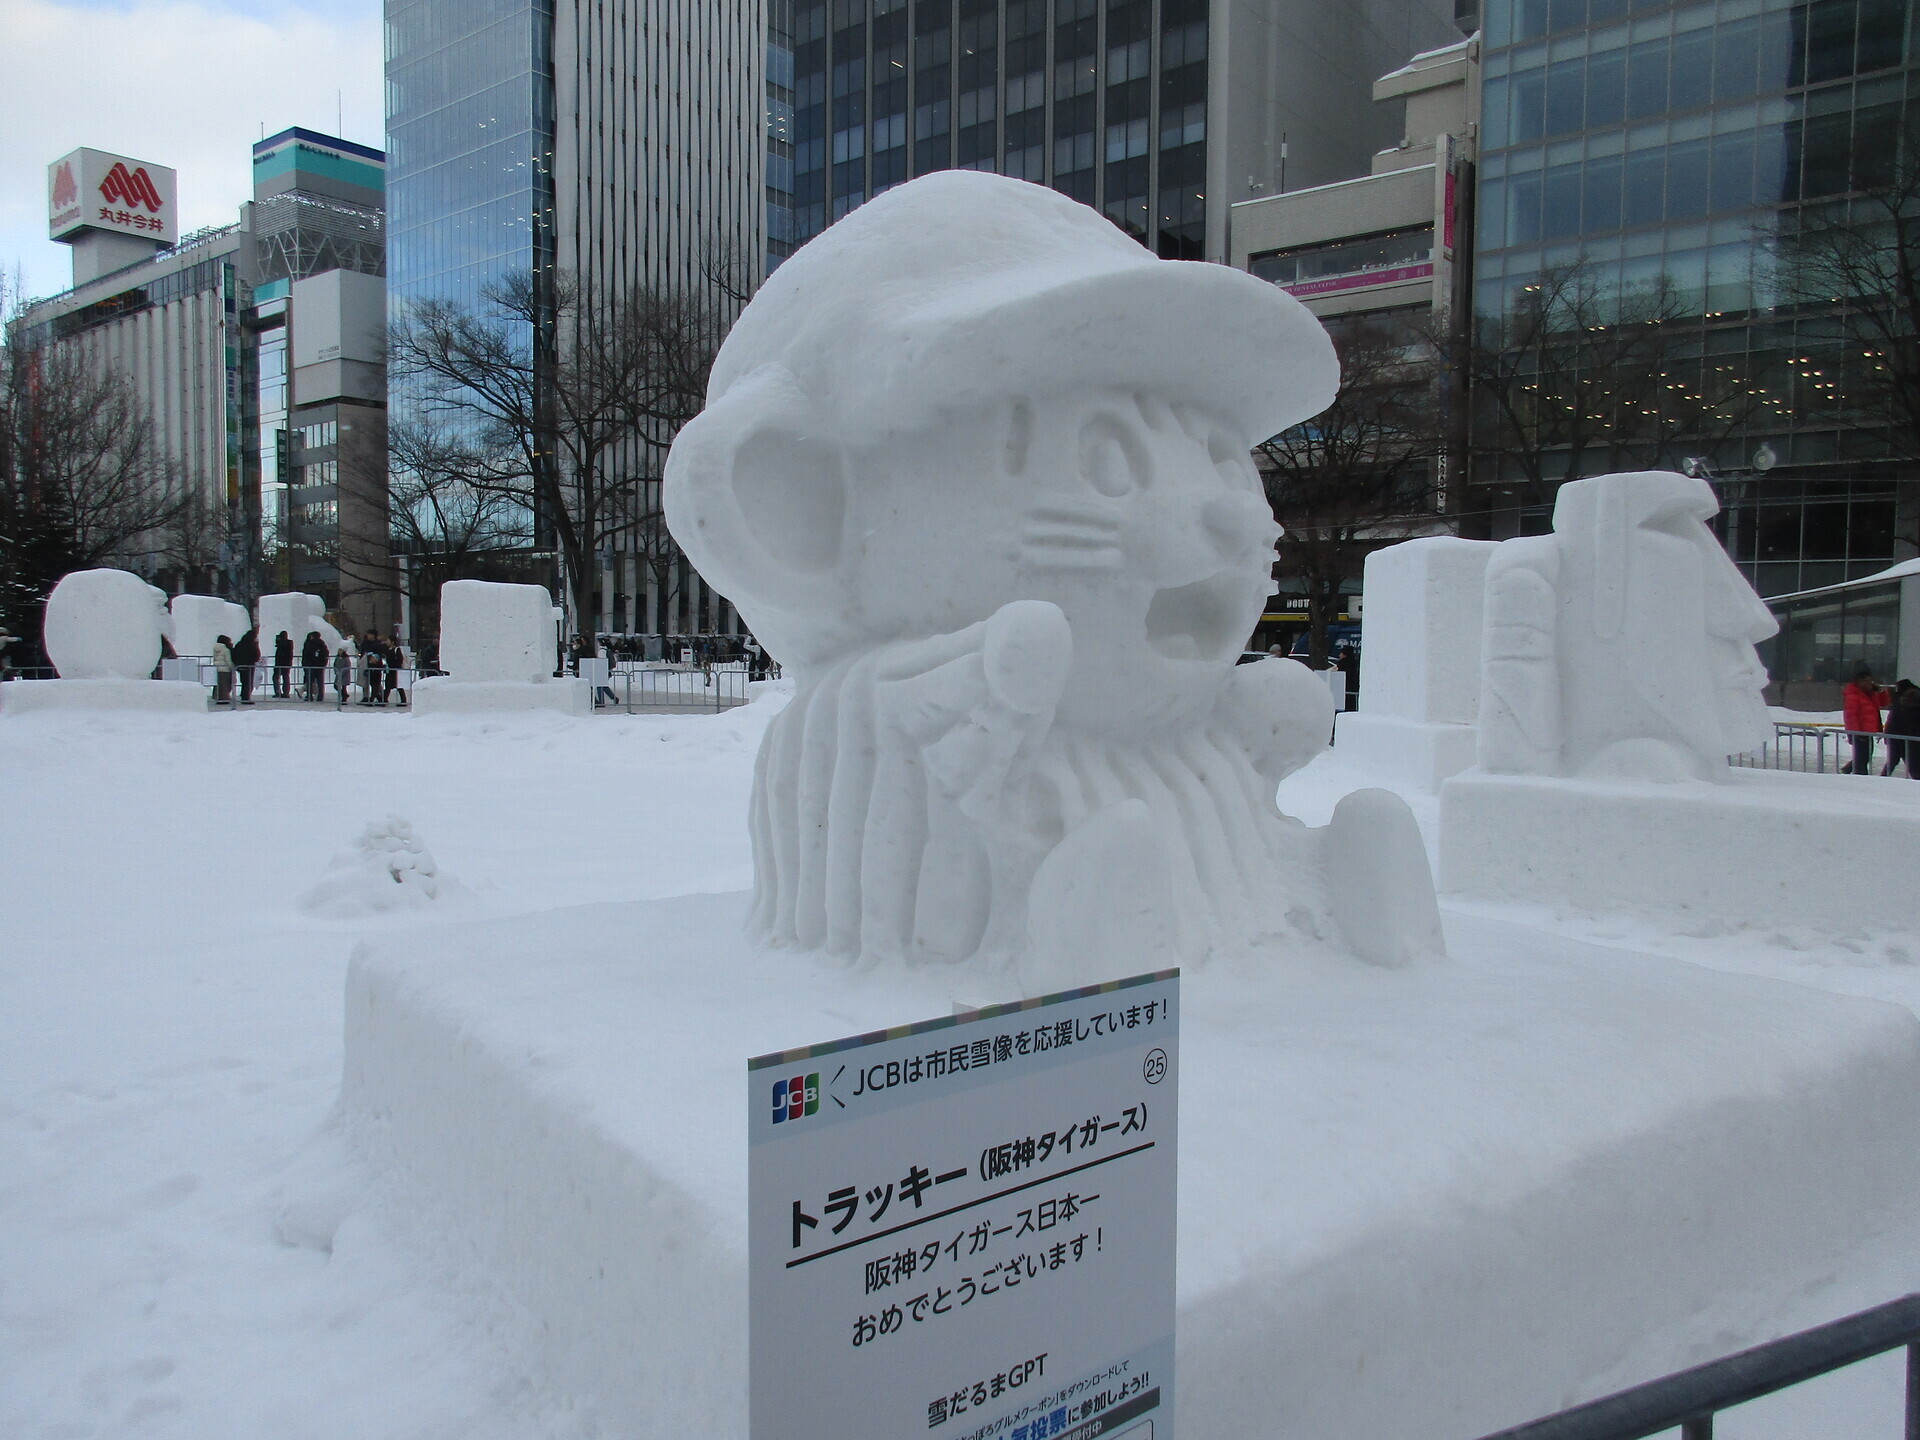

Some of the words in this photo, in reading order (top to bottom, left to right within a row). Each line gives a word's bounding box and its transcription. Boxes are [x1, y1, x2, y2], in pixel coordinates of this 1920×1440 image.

[98, 206, 164, 233] 丸井今井
[852, 1226, 1103, 1347] おめでとうございます！
[864, 1192, 1100, 1295] 阪神タイガース日本一
[927, 1353, 1049, 1429] 雪だるまGPT
